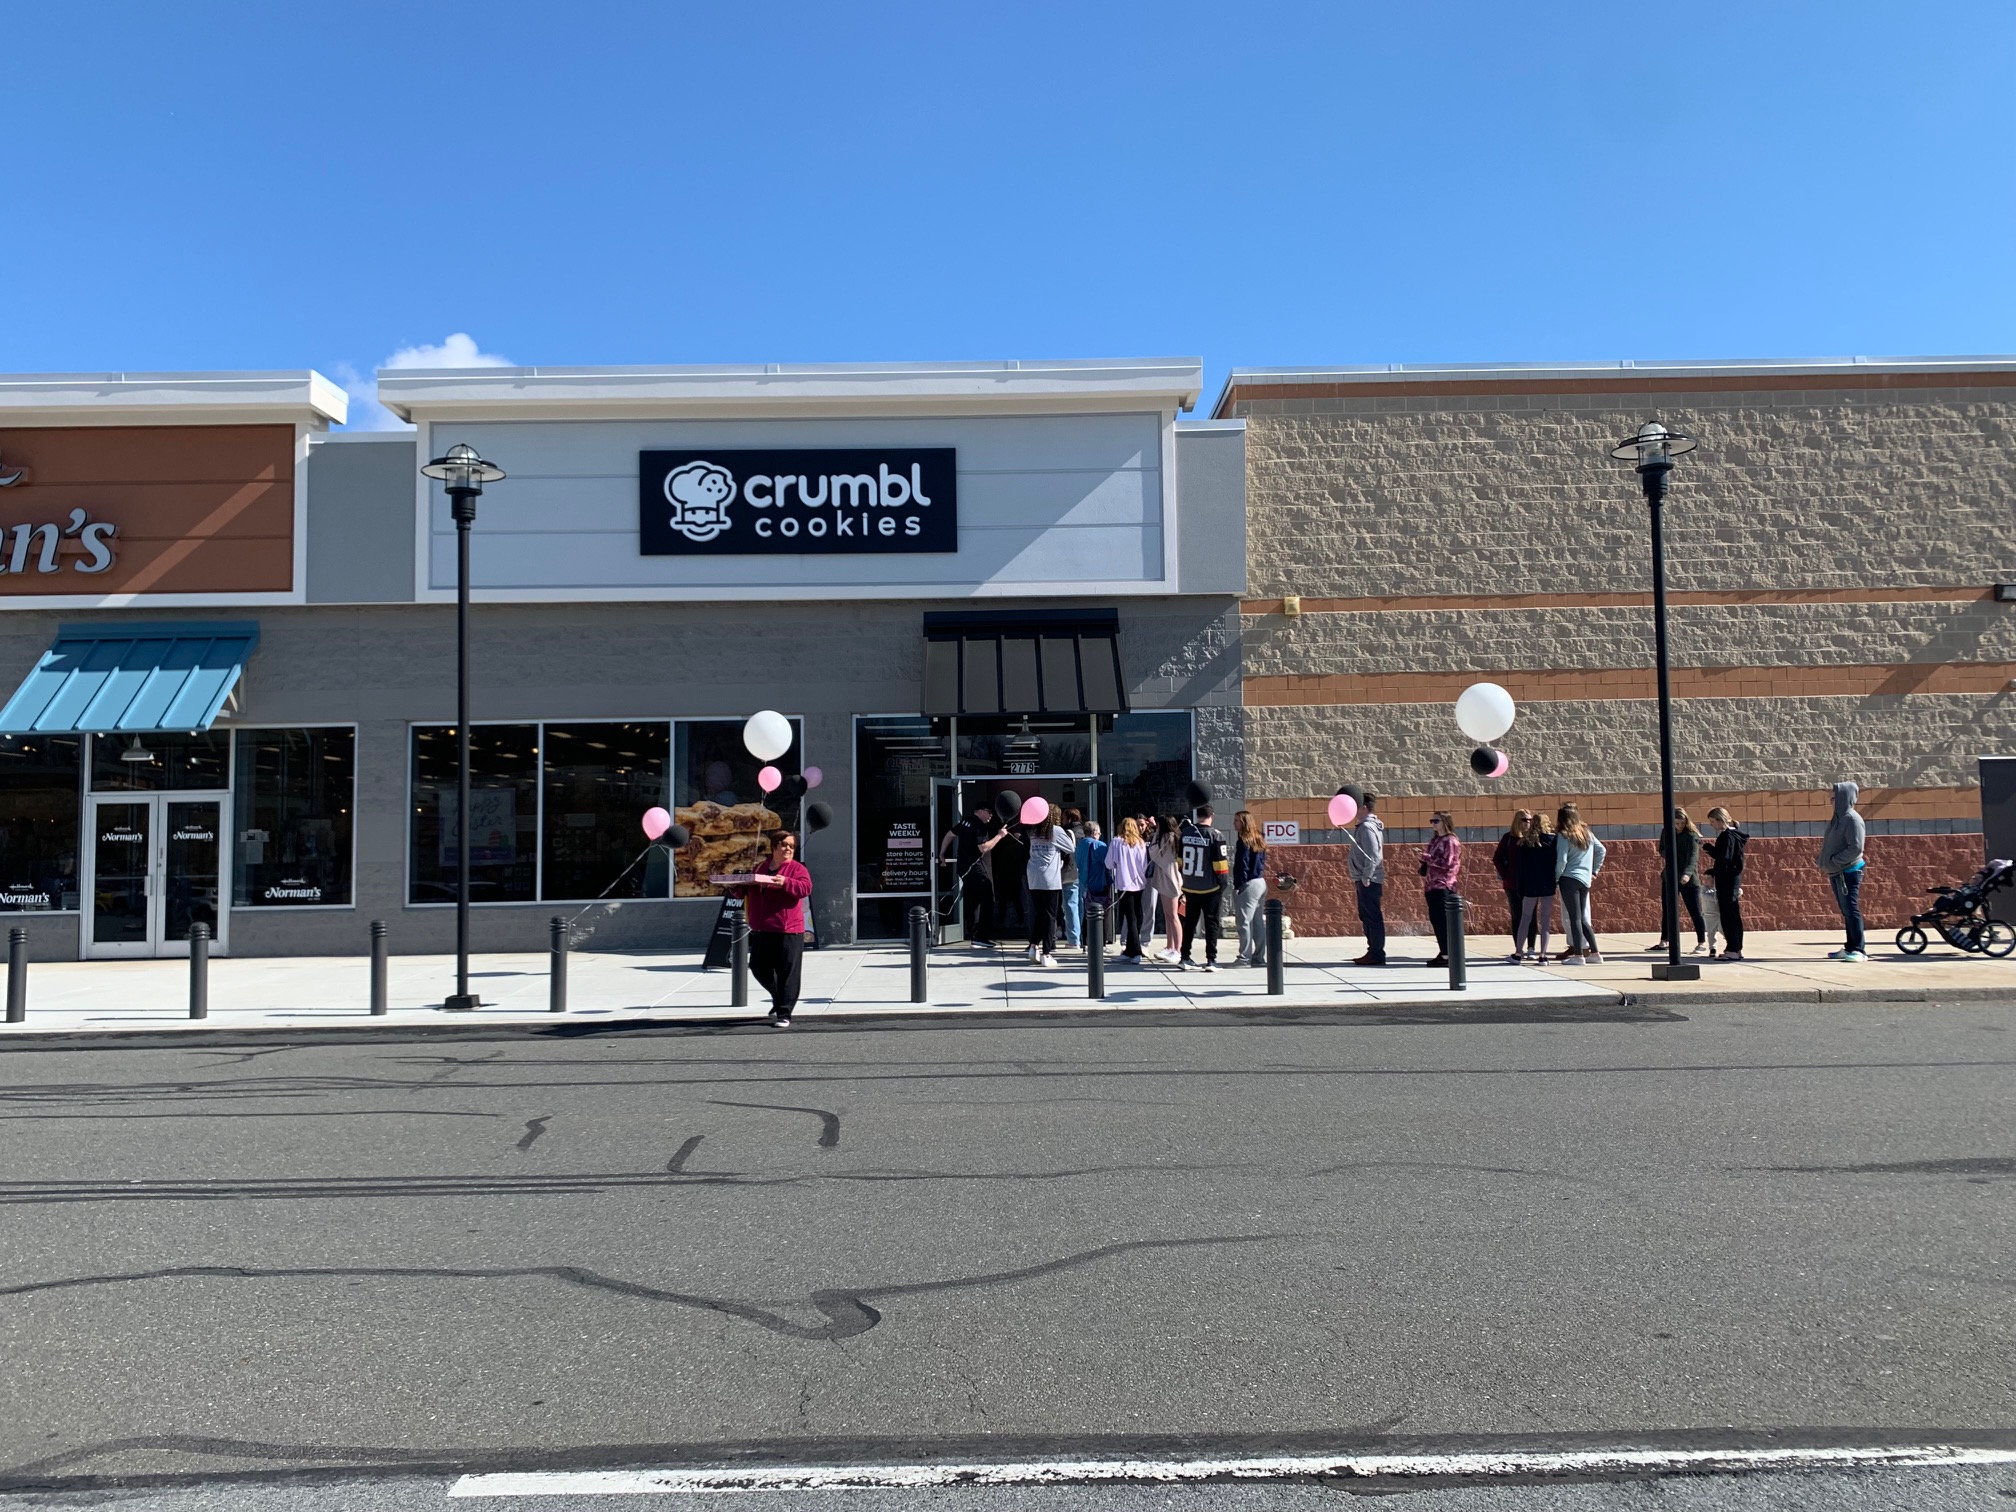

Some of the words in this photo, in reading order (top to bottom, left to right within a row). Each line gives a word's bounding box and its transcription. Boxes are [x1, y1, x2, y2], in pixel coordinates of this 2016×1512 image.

[743, 462, 932, 508] crumbl
[754, 509, 922, 538] cookies
[0, 507, 117, 574] n's
[1011, 762, 1034, 773] 2779
[102, 832, 143, 842] Norman's
[172, 830, 214, 840] Norman's
[1266, 824, 1296, 837] FDC
[1182, 846, 1205, 877] 81
[264, 886, 322, 899] Norman's
[725, 898, 744, 908] NOW
